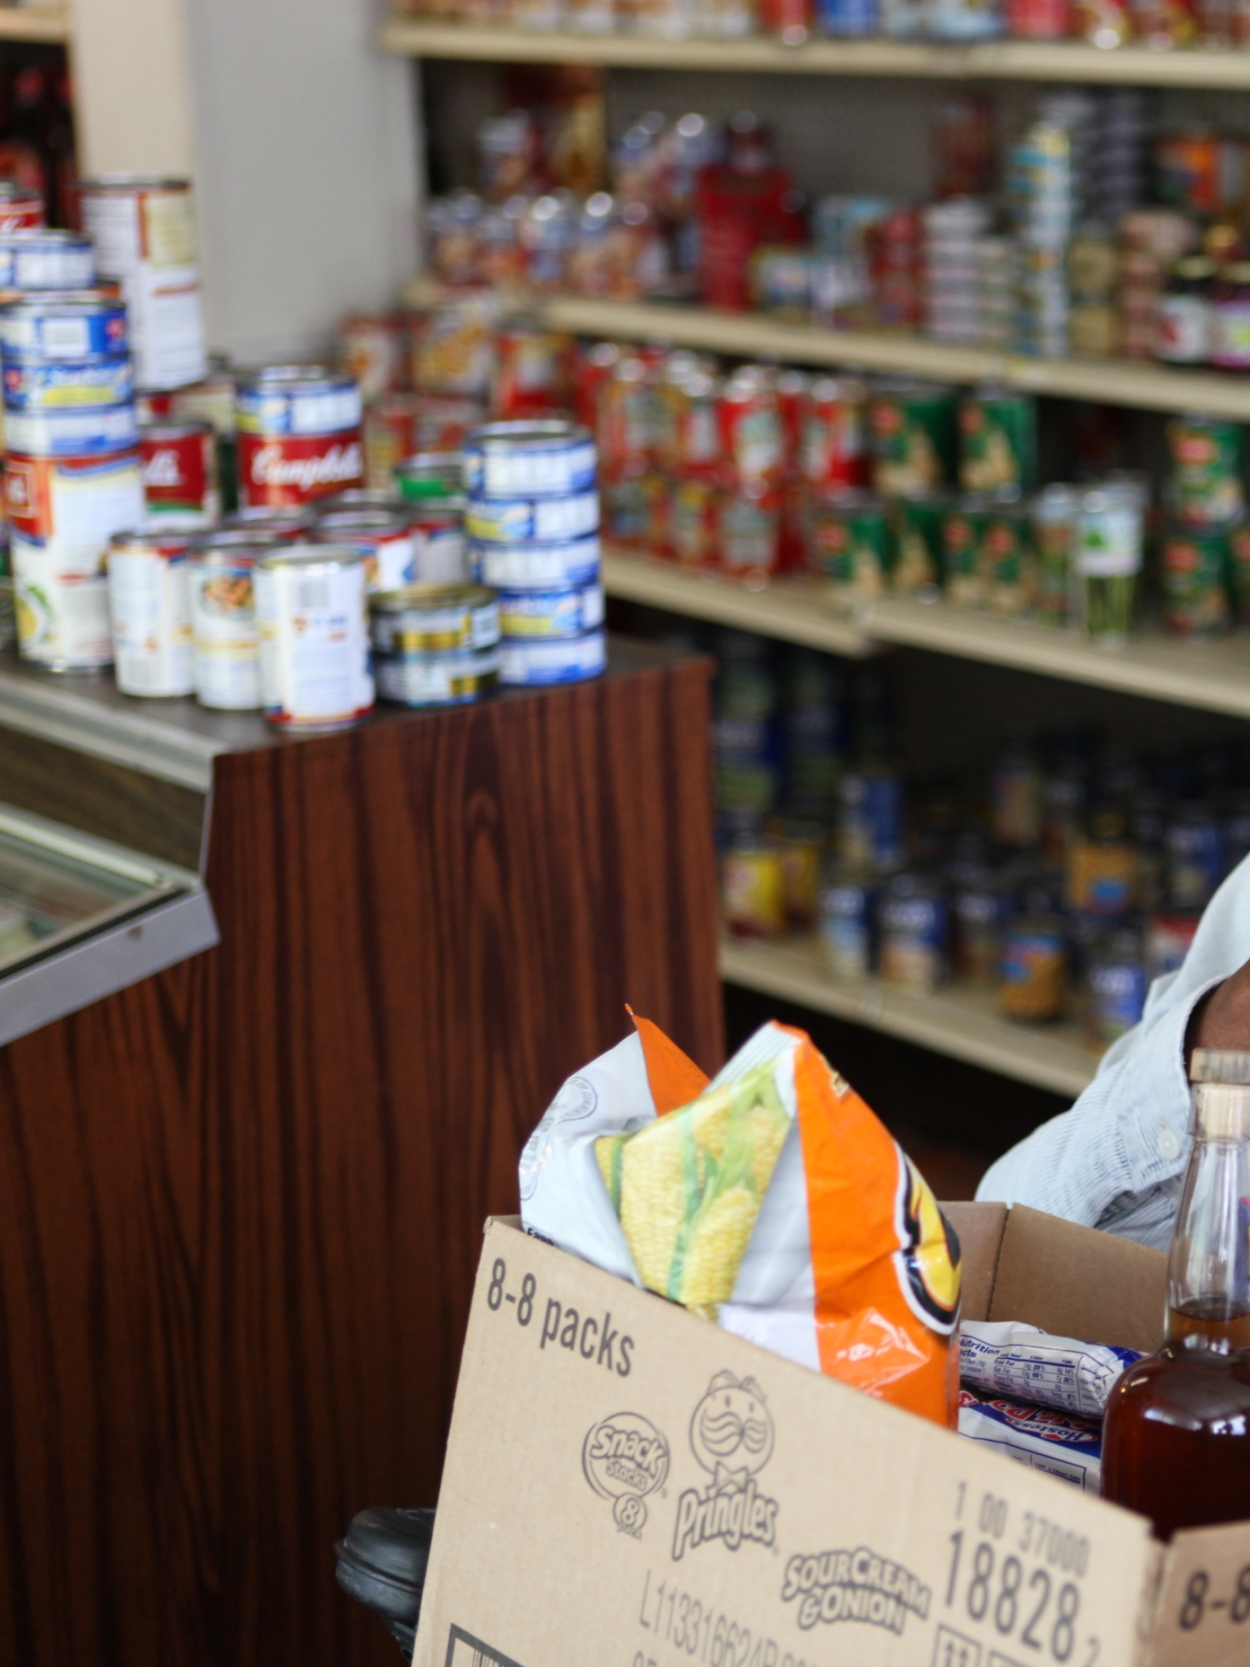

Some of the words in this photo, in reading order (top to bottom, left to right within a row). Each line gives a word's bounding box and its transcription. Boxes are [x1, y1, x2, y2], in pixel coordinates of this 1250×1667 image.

[487, 1257, 537, 1327] 8-8
[539, 1297, 635, 1378] packs
[589, 1424, 670, 1480] Snack
[605, 1457, 650, 1492] Stacks
[620, 1497, 640, 1526] 8
[671, 1478, 780, 1562] Pringles
[955, 1481, 968, 1520] 1
[781, 1551, 851, 1602] SOUR
[850, 1546, 932, 1621] CREAM
[820, 1585, 906, 1636] ONION
[945, 1530, 1081, 1663] 18828
